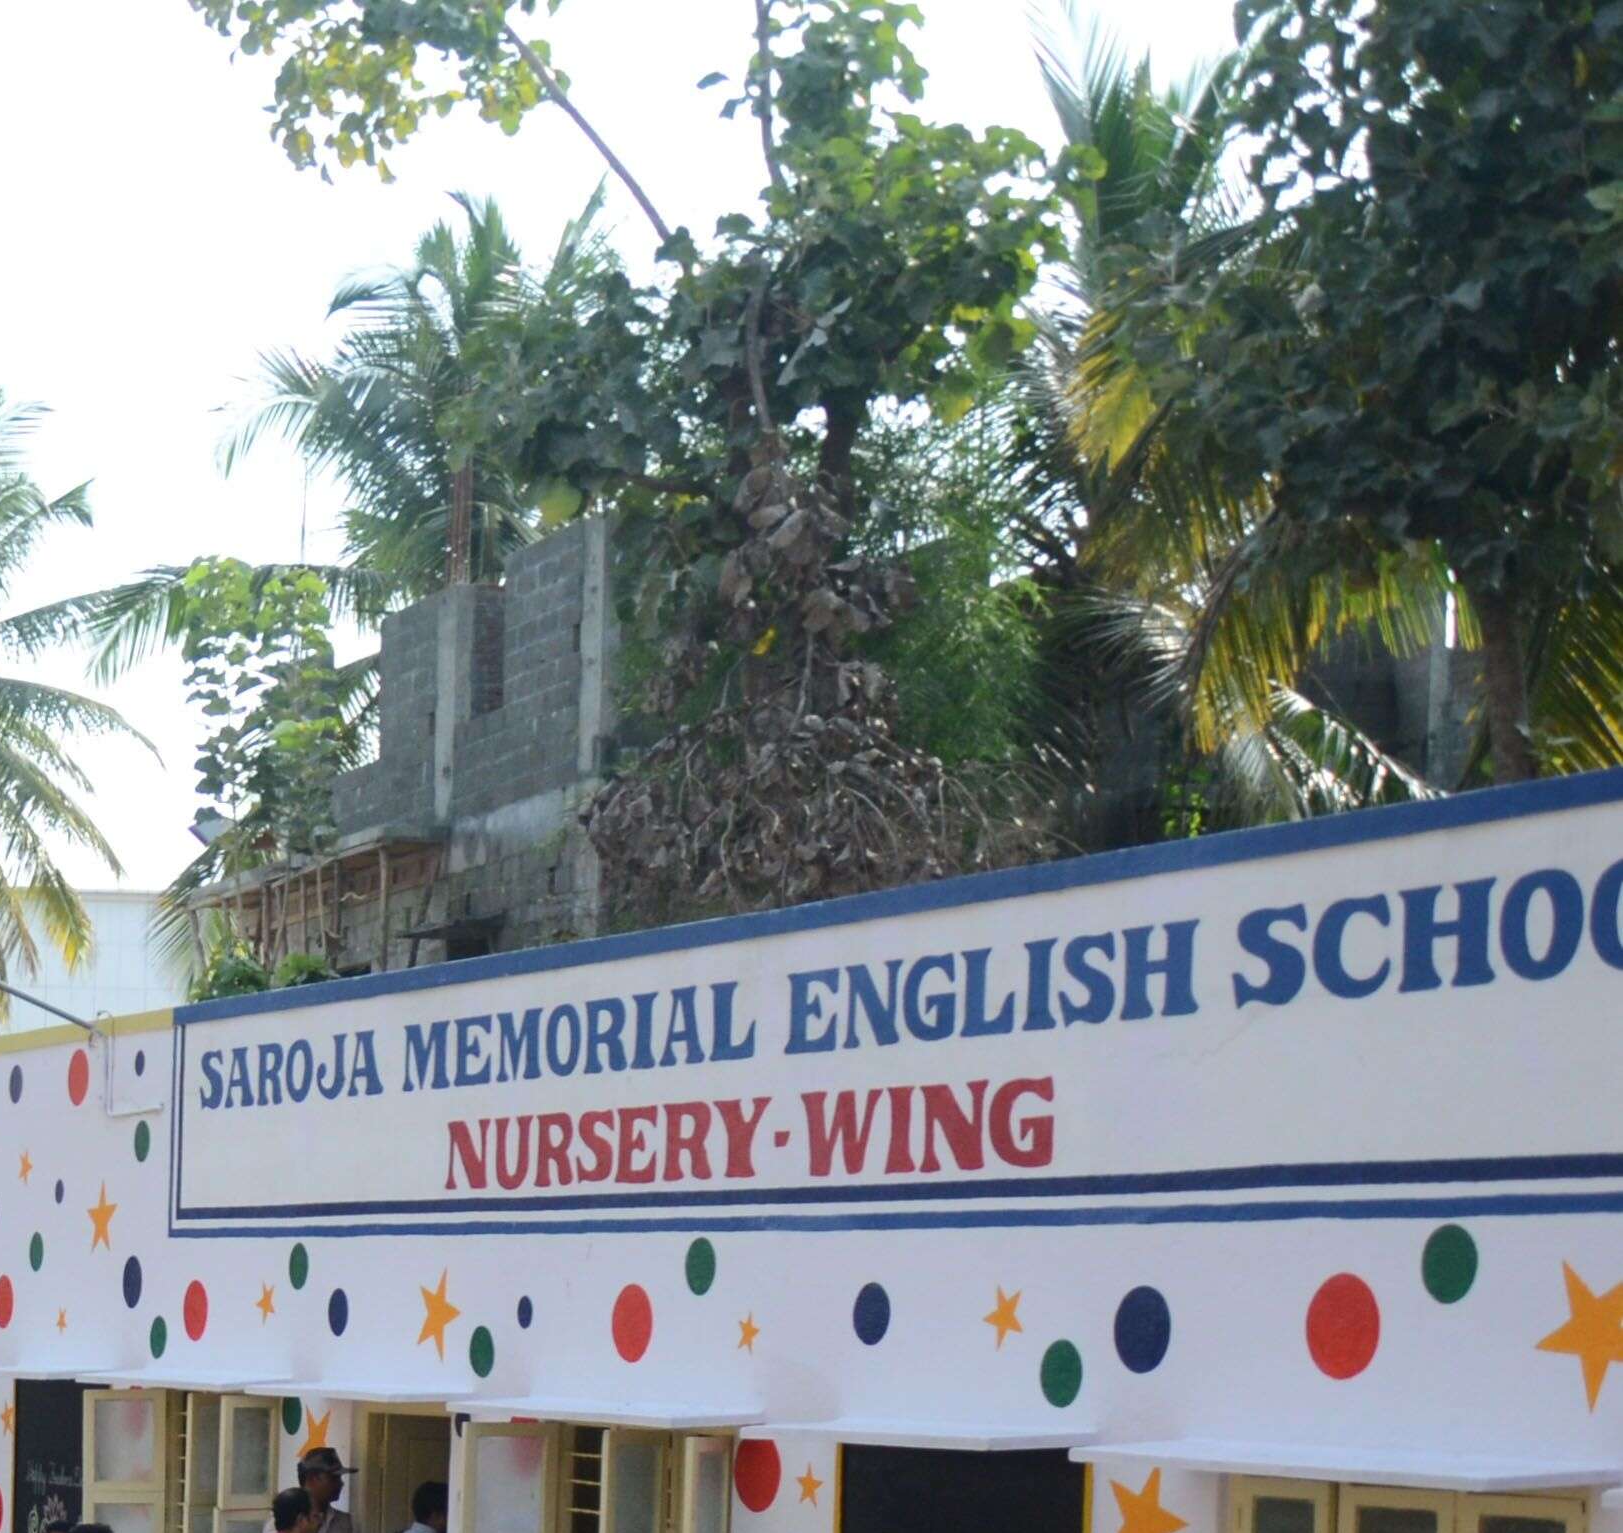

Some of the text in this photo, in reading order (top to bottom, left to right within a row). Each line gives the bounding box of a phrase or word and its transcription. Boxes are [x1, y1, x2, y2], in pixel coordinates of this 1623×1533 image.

[199, 1030, 384, 1110] SAROJA
[402, 980, 757, 1092] MEMORIAL
[785, 917, 1201, 1056] ENGLISH
